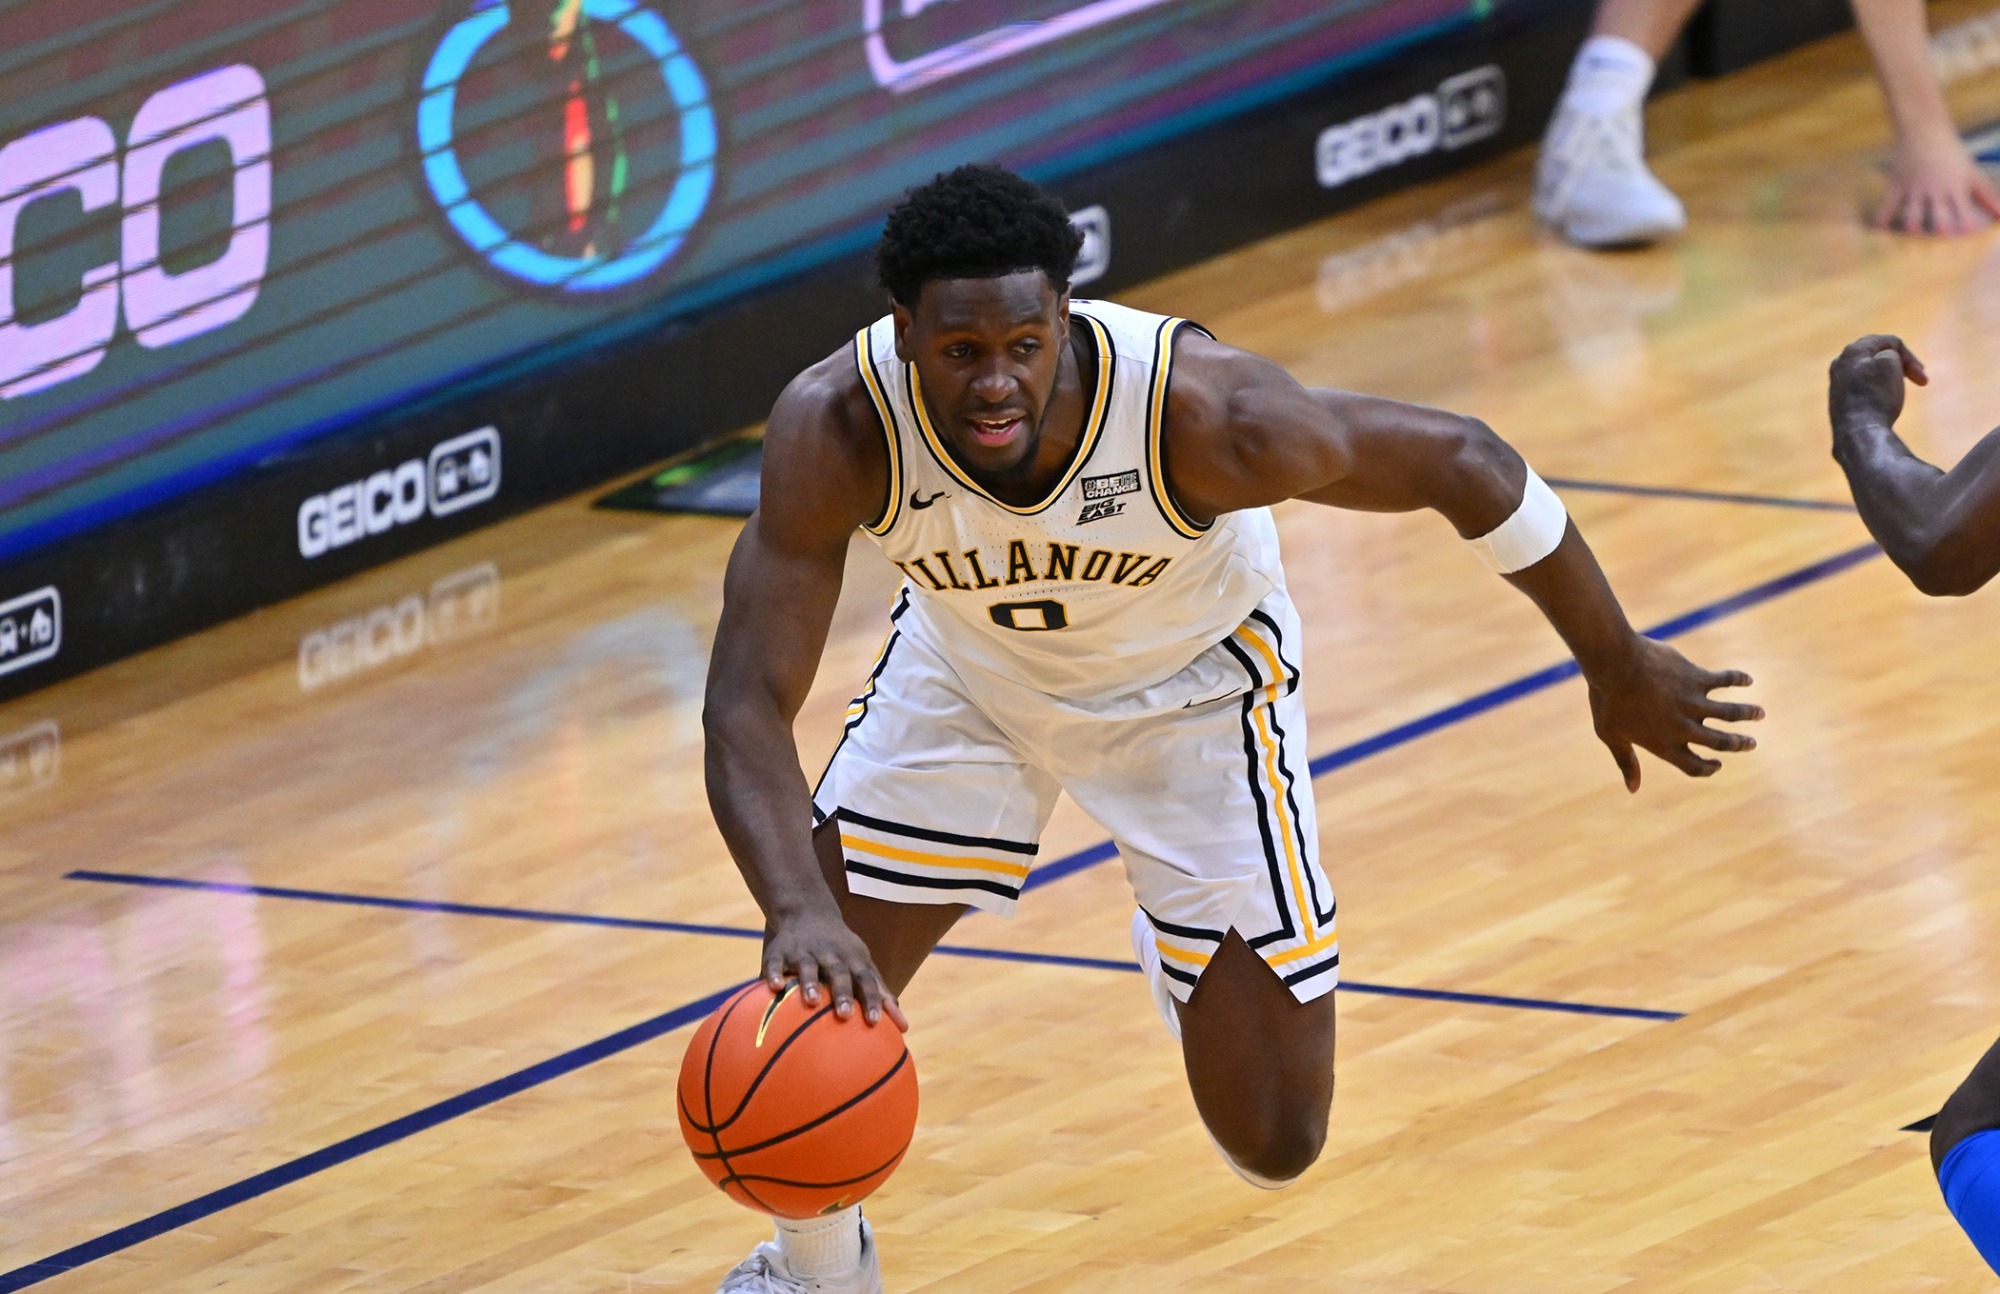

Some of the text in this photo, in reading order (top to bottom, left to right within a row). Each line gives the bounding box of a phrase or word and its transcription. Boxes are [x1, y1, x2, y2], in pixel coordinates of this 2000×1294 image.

[1087, 483, 1137, 497] CHANGE
[297, 457, 426, 559] GEICO
[1078, 503, 1126, 521] EAST
[1082, 498, 1115, 512] BIG
[989, 599, 1071, 631] 0
